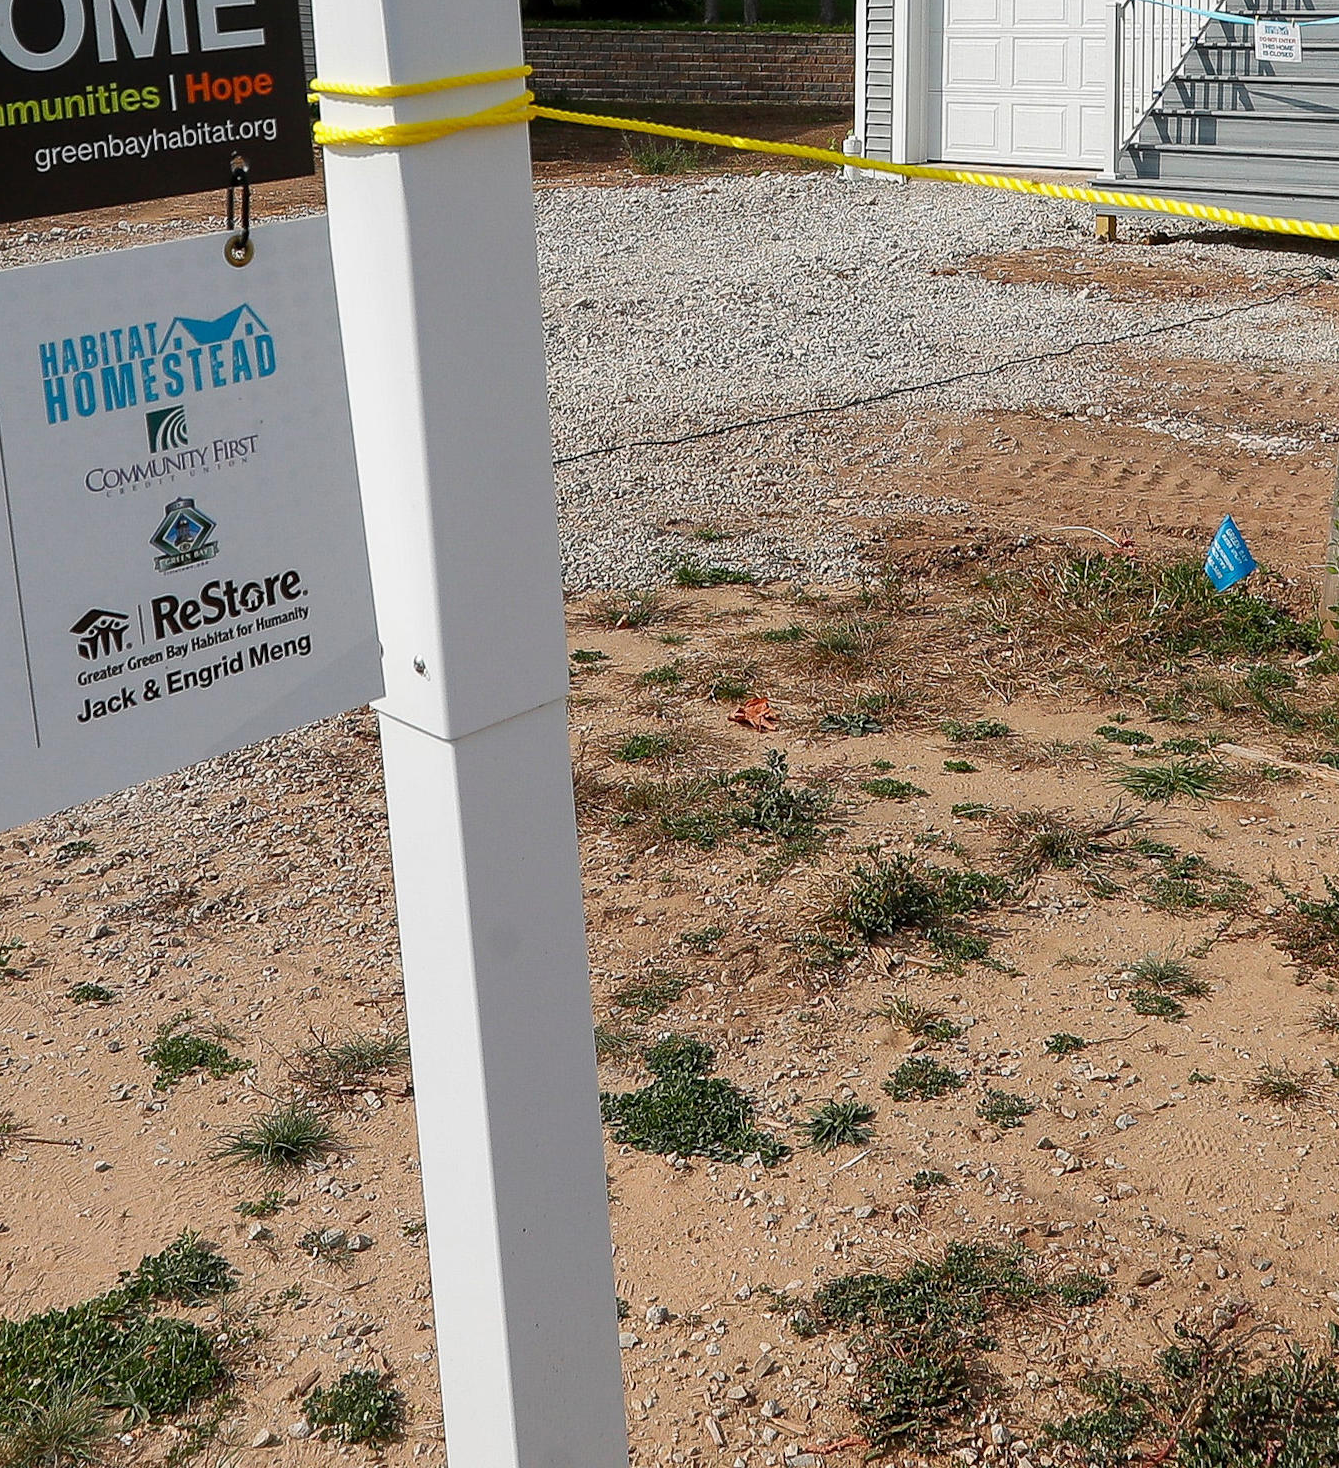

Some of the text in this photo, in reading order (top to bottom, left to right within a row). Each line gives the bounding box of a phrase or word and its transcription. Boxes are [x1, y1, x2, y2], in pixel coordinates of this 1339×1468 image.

[184, 73, 274, 107] Hope
[34, 115, 278, 173] greenbayhabitat.org
[39, 322, 158, 378] HABITAT
[43, 334, 277, 424] HOMESTEAD
[86, 435, 259, 493] COMMUNITY FIRST
[106, 458, 248, 498] CREDIT UNION
[77, 606, 310, 686] Greater Green Bay Habitat for Humanity
[77, 633, 312, 723] Jack & Engrid Meng
